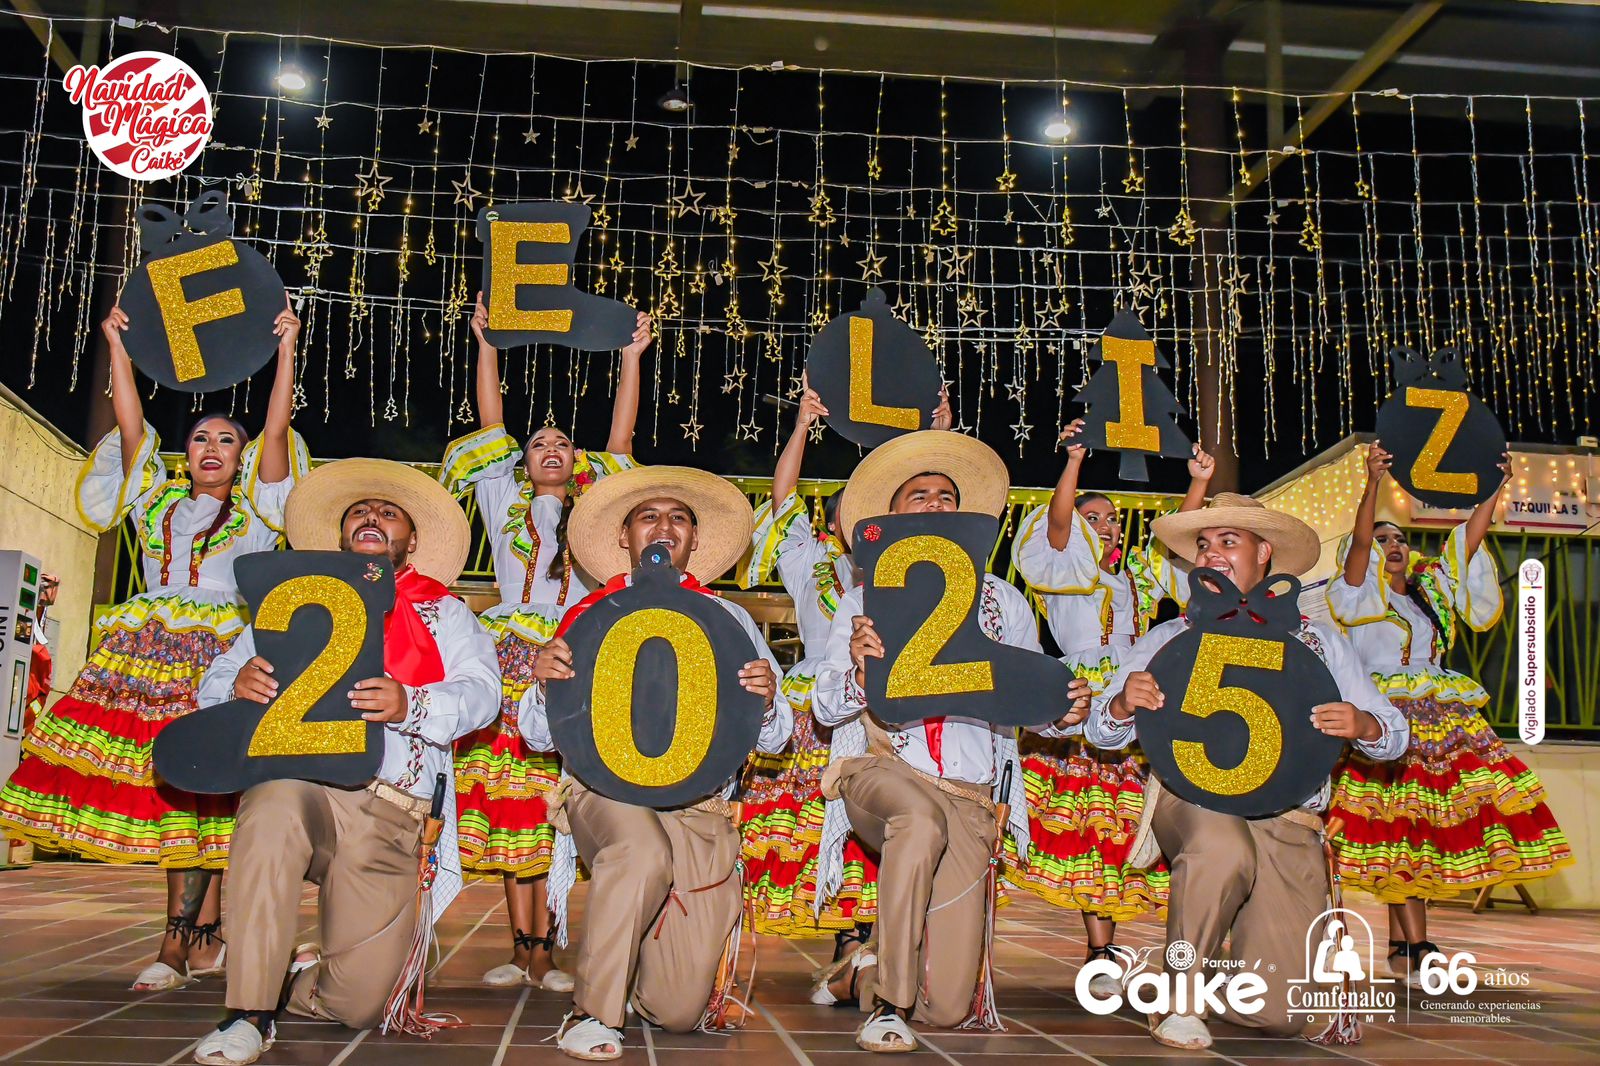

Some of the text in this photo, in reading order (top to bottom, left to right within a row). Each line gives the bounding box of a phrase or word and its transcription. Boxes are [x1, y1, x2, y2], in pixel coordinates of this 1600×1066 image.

[146, 240, 246, 382] F
[488, 221, 573, 332] E
[849, 316, 921, 430] L
[1101, 335, 1160, 452] I
[1406, 386, 1478, 495] Z
[247, 575, 367, 757] 2
[873, 535, 994, 699] 2
[1172, 633, 1284, 795] 5
